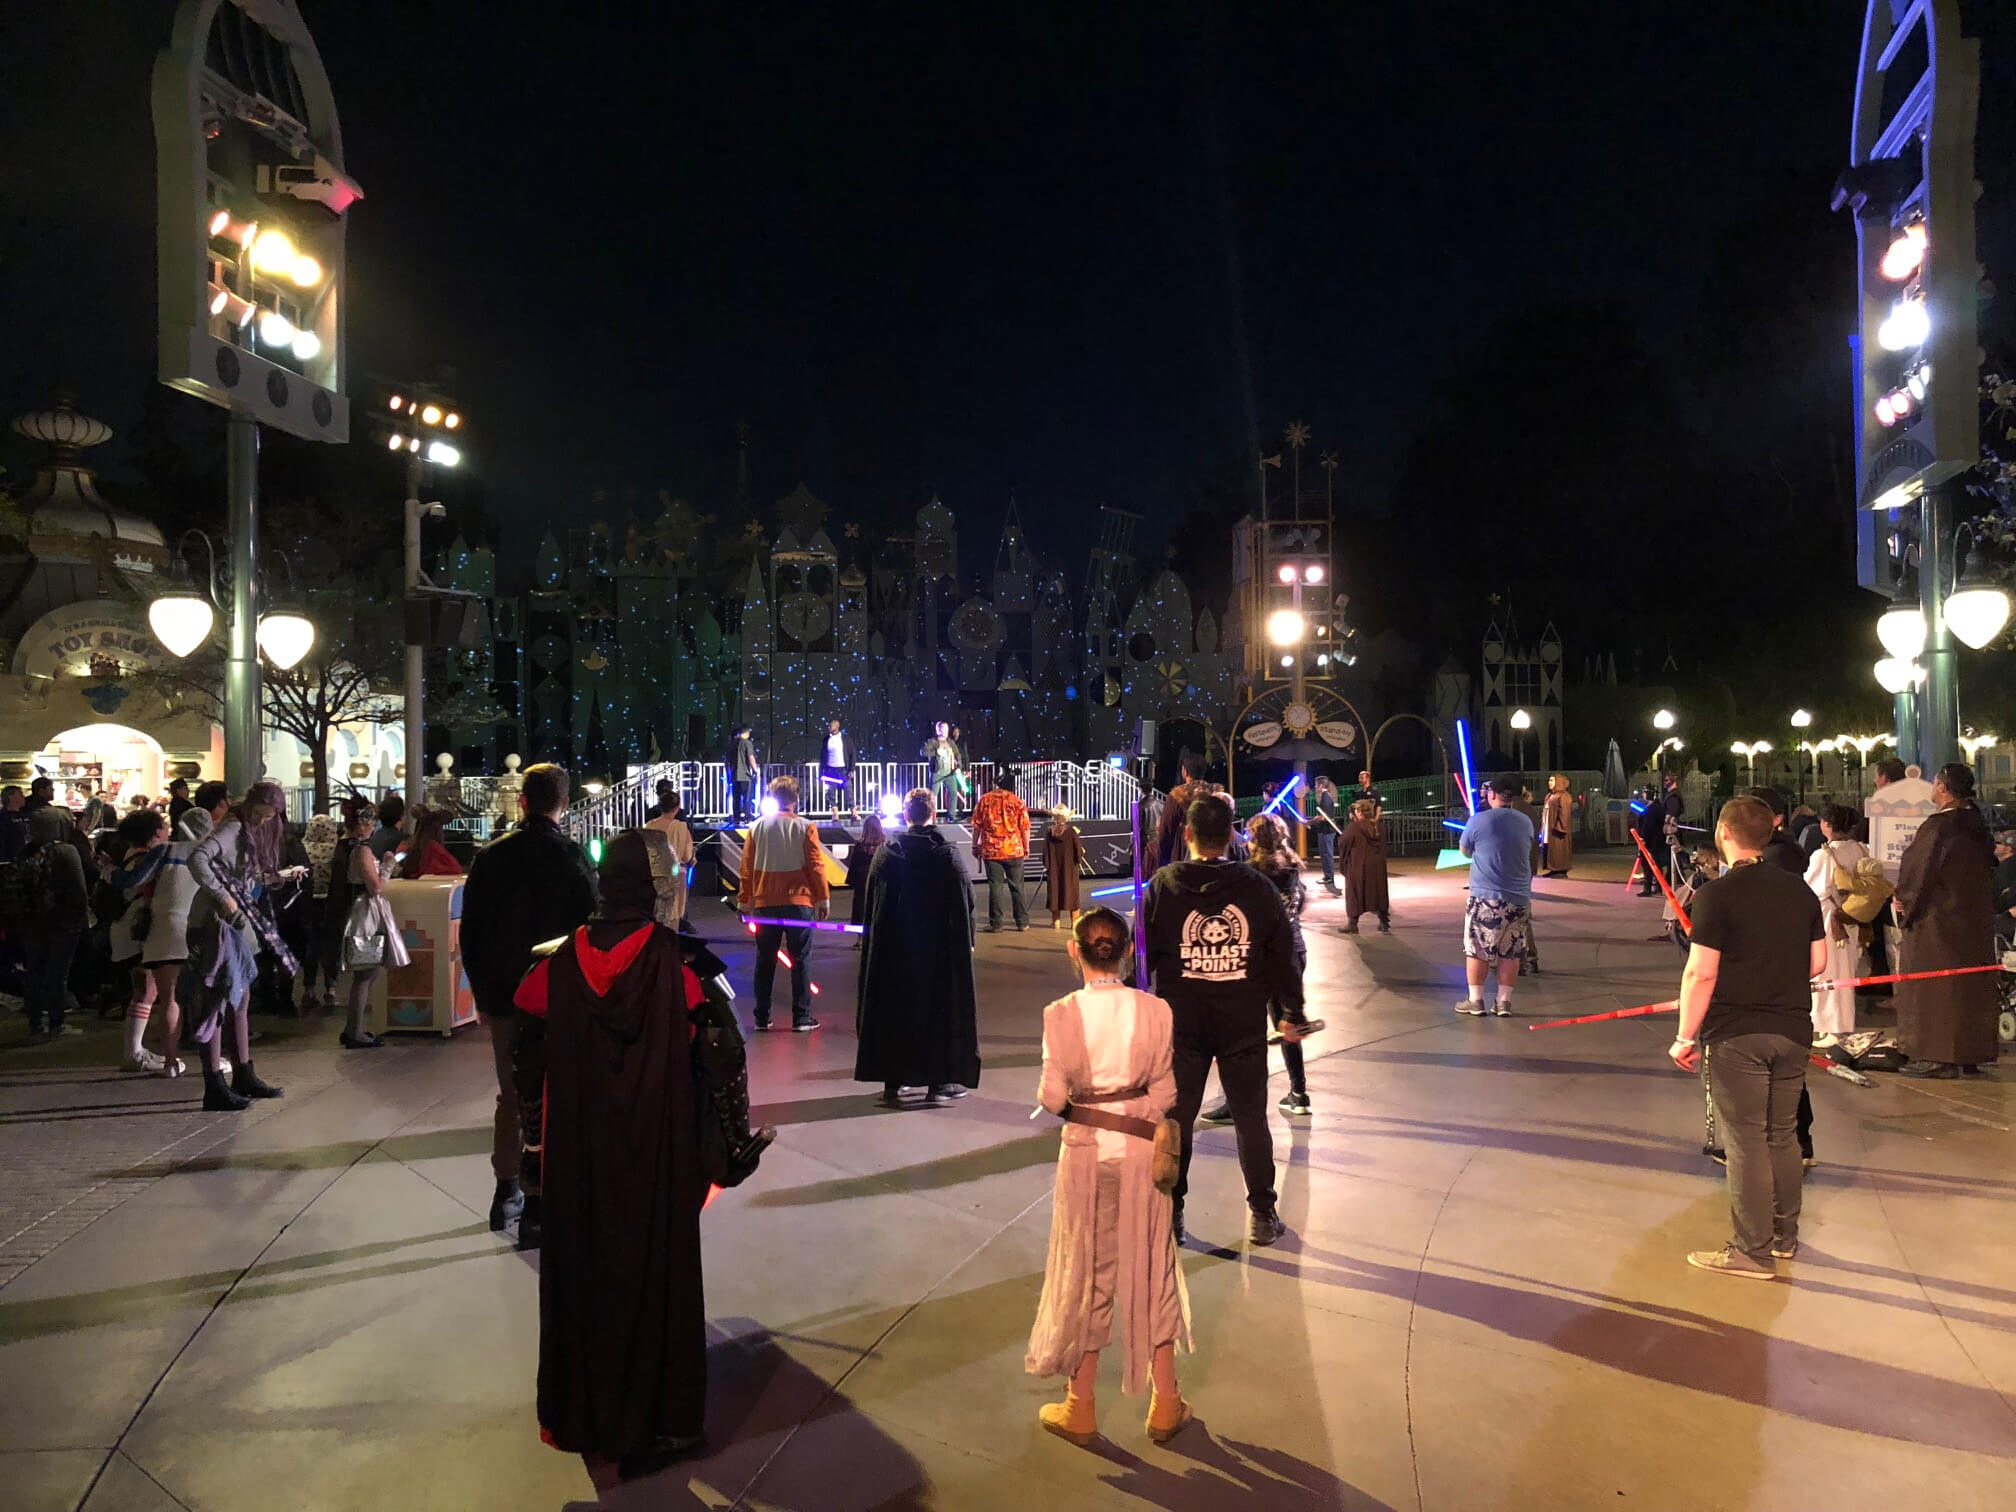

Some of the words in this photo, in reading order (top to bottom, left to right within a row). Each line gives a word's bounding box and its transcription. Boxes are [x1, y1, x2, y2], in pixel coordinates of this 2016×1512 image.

[49, 632, 93, 659] TOY
[1895, 823, 1918, 831] Plea
[1181, 945, 1249, 959] BALLAST
[1191, 958, 1240, 972] POINT
